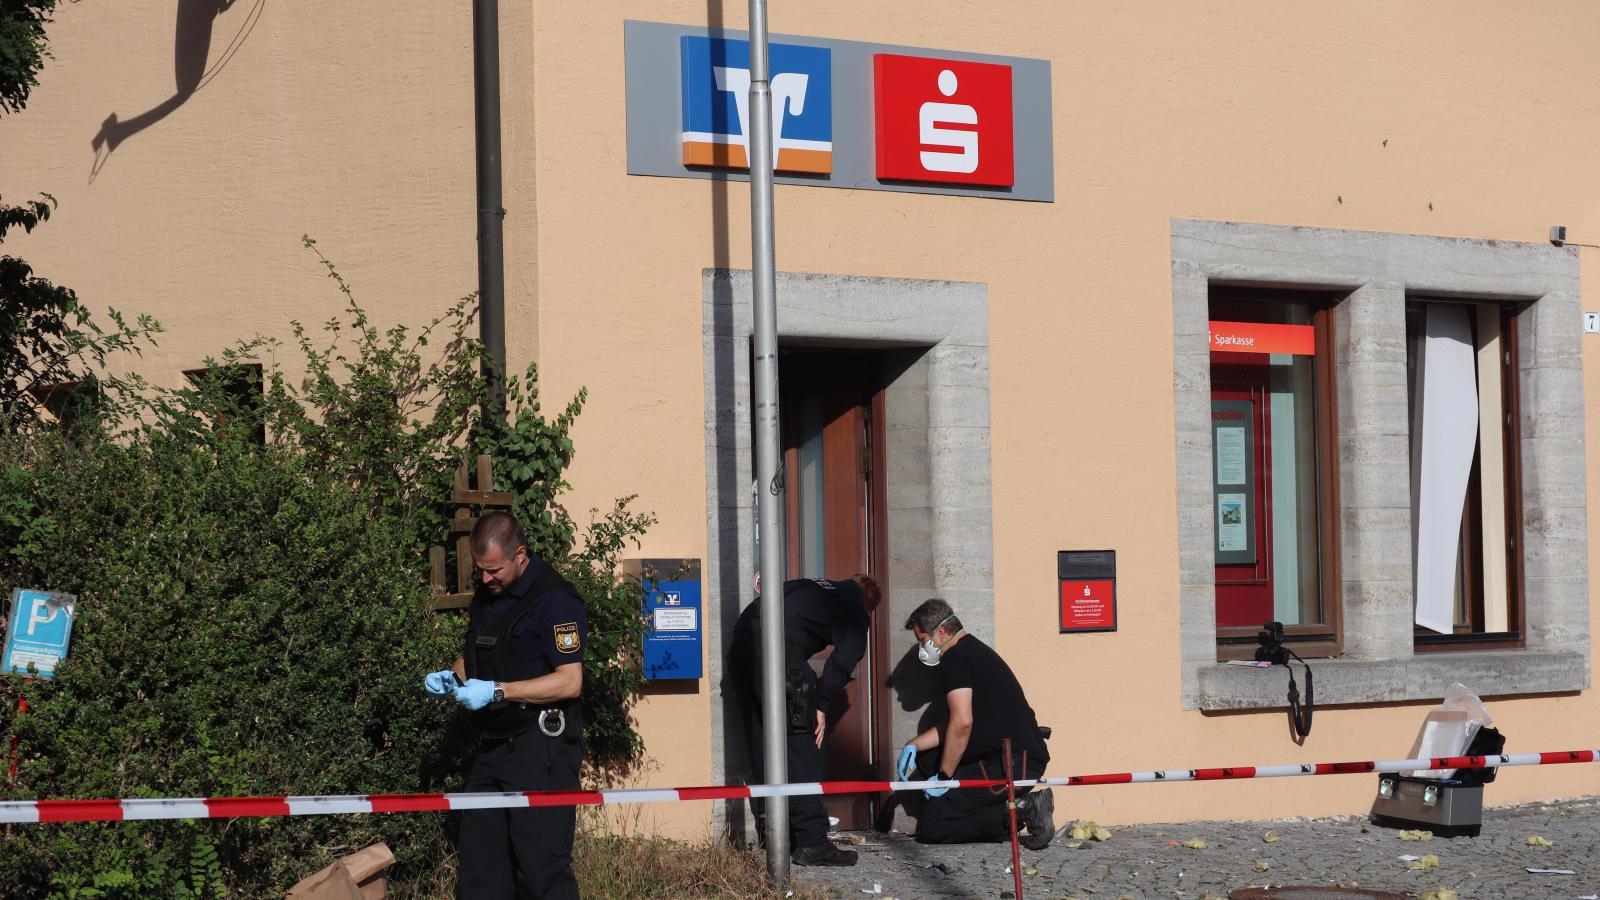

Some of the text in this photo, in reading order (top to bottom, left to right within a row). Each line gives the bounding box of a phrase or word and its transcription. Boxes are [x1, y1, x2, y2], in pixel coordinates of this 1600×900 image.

[1589, 315, 1595, 329] 7
[1214, 334, 1255, 347] Sparkasse
[27, 598, 58, 636] P
